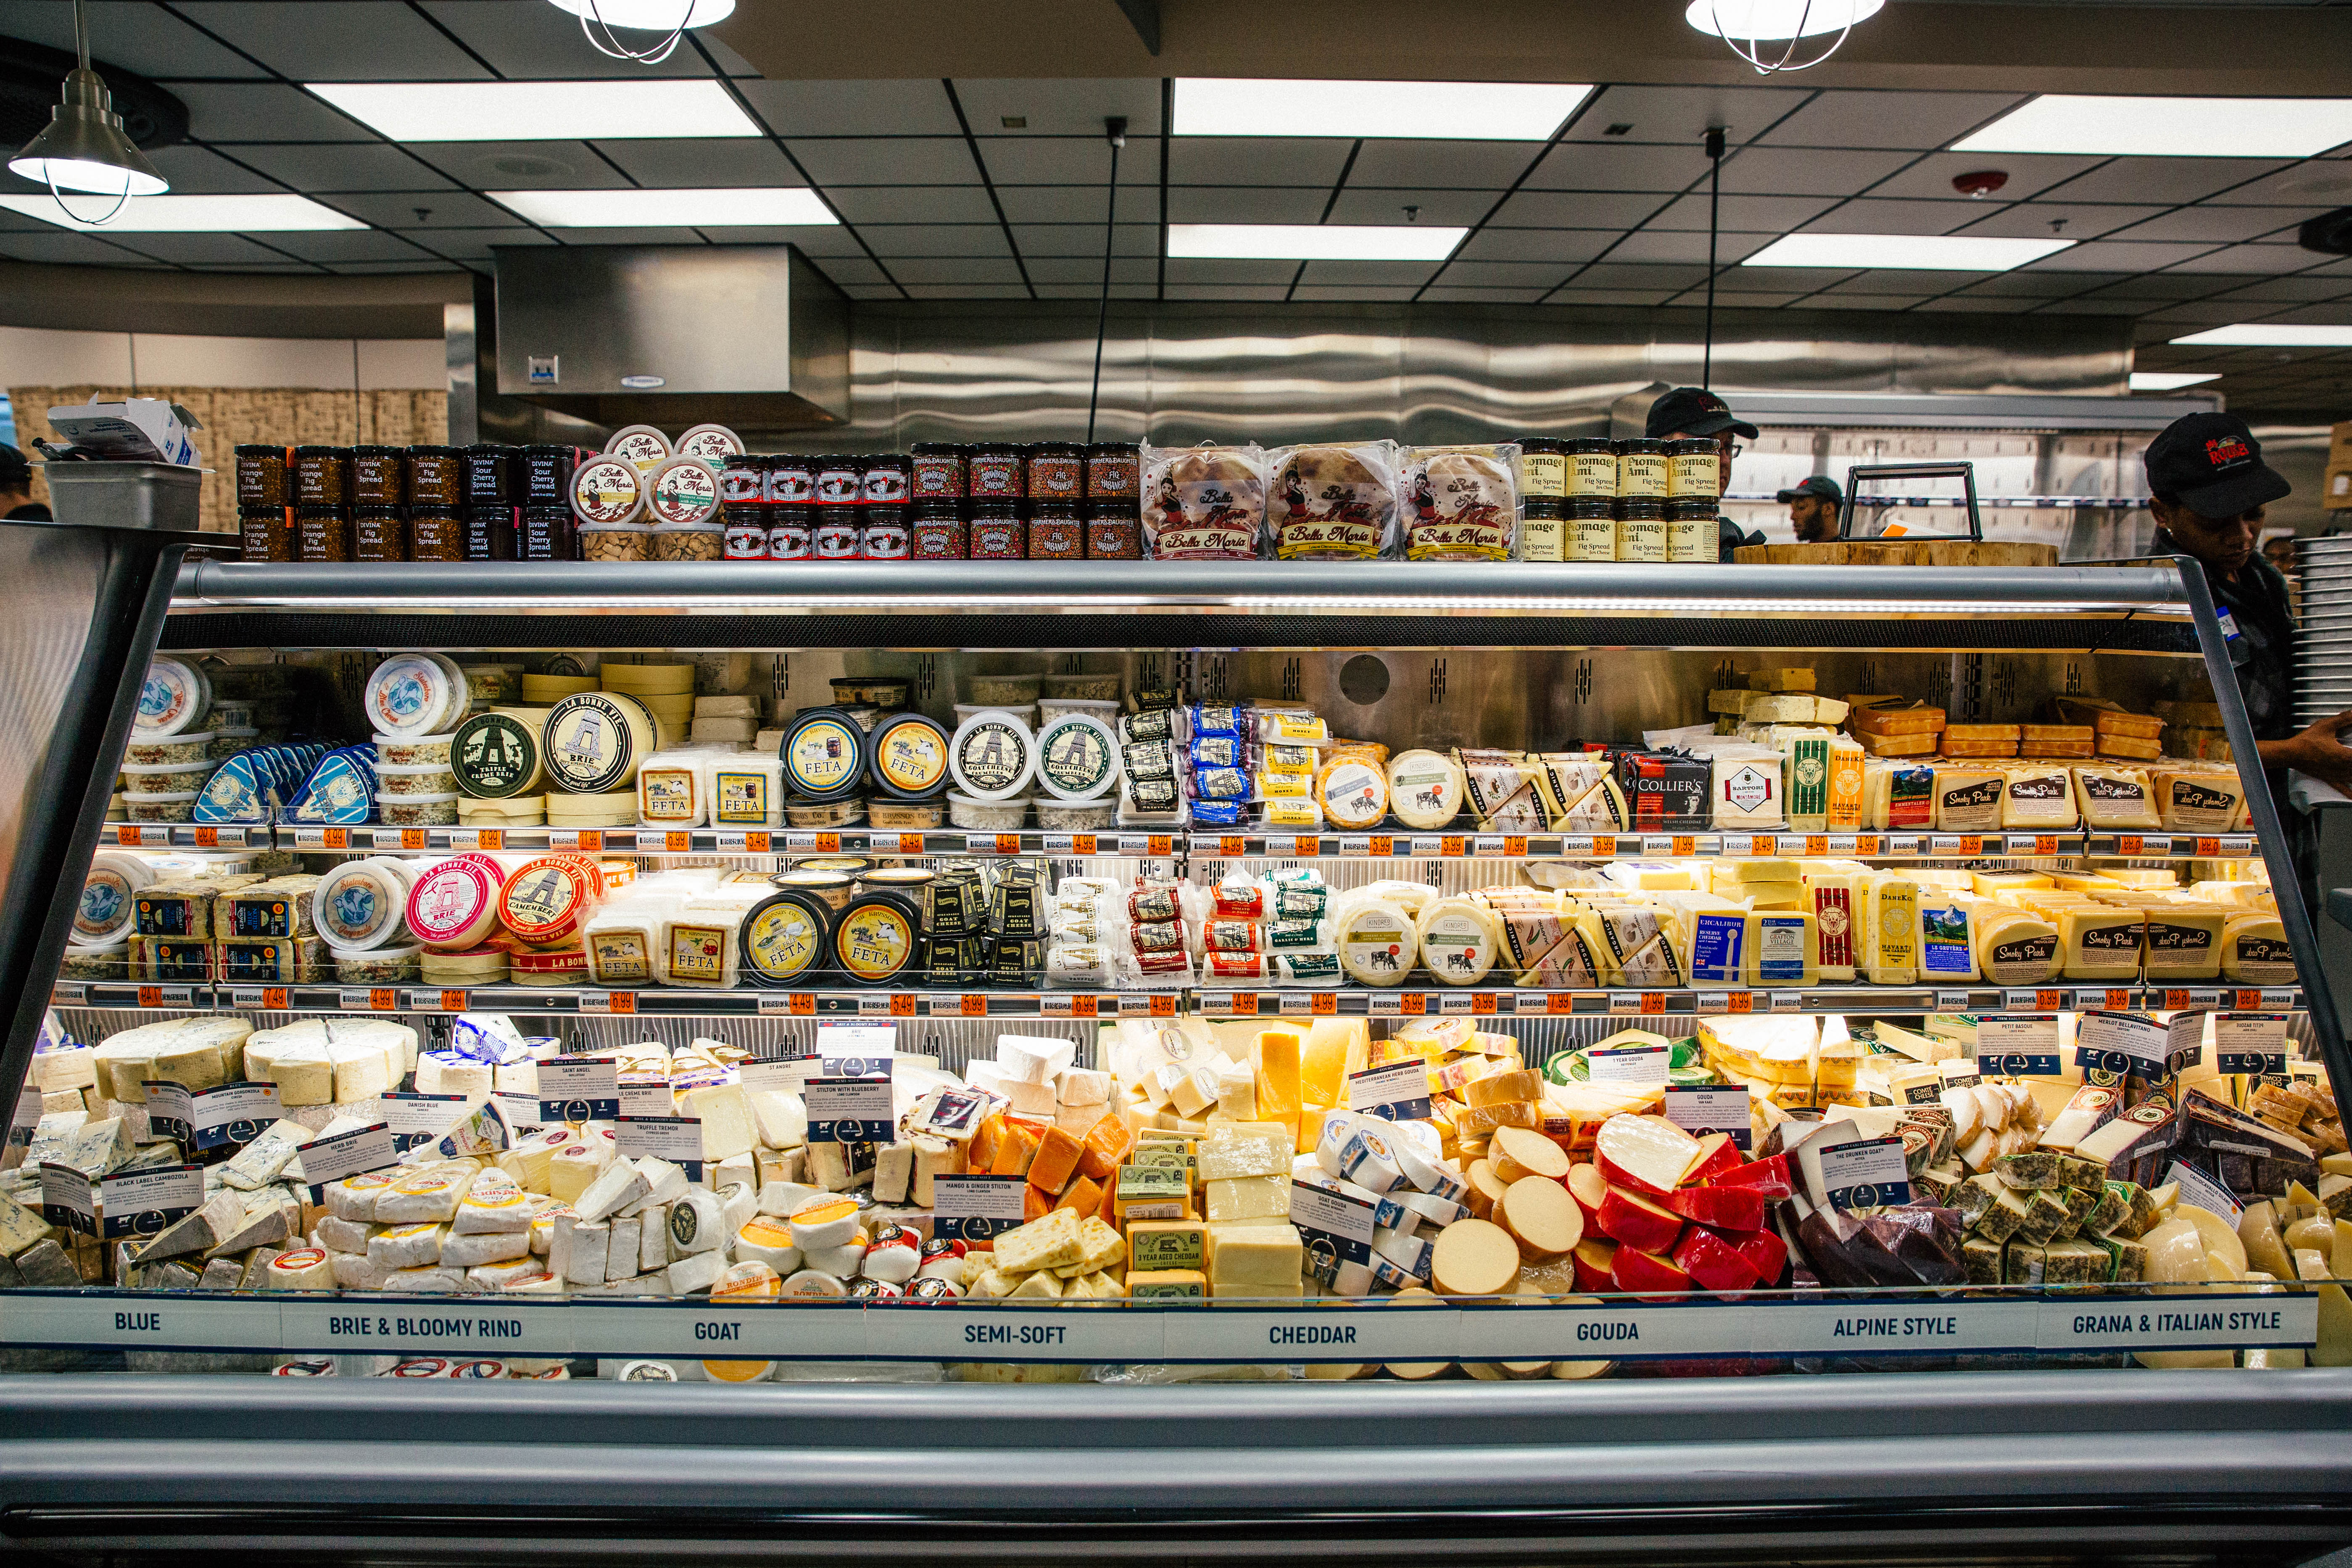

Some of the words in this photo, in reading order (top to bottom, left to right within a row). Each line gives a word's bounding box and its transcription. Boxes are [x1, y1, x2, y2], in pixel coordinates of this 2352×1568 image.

[913, 458, 931, 467] FARMER'S
[932, 458, 959, 467] DAUGHTER
[1672, 458, 1716, 468] Fromage
[599, 467, 624, 477] Bella
[680, 469, 704, 480] Bella
[920, 470, 947, 482] STRAWBERRY
[1109, 471, 1120, 480] FIG
[1101, 480, 1128, 490] HABANERO
[1165, 534, 1200, 548] Bella
[1205, 532, 1247, 551] María
[1418, 528, 1453, 543] Bella
[1456, 528, 1498, 547] María
[565, 698, 577, 709] LA
[580, 697, 608, 710] BONNE
[610, 708, 623, 728] VIE.
[570, 754, 595, 764] BRIE
[805, 761, 842, 774] FETA
[987, 765, 1012, 773] CHEESE
[1639, 779, 1702, 791] COLLIER'S
[1470, 780, 1485, 810] ORGANIC
[1950, 793, 1970, 806] Smoky
[1972, 792, 1991, 803] Park
[651, 801, 686, 812] FETA
[725, 800, 759, 811] FETA
[340, 878, 373, 891] Statesboro
[433, 910, 456, 920] BRIE
[509, 902, 556, 919] CAMEMBERT
[338, 925, 373, 937] Gorgonzola
[772, 945, 781, 953] FAT
[782, 937, 797, 947] FREE
[769, 942, 806, 967] FETA
[2098, 1019, 2117, 1027] MERLOT
[2119, 1022, 2151, 1033] BELLAVITANO
[1355, 1074, 1391, 1085] MEDITERRANEAN
[155, 1174, 188, 1183] CAMBOZOLA
[2190, 1174, 2218, 1194] CACIOCAVALLO
[2218, 1193, 2230, 1205] SILANO
[1331, 1199, 1347, 1209] GOUDA
[115, 1312, 161, 1331] BLUE
[330, 1318, 370, 1335] BRIE
[378, 1319, 390, 1336] &
[397, 1319, 473, 1337] BLOOMY
[479, 1319, 522, 1338] RIND
[1833, 1318, 1900, 1337] ALPINE
[1904, 1317, 1956, 1336] STYLE
[2073, 1313, 2133, 1334] GRANA
[2138, 1313, 2150, 1333] &
[2157, 1312, 2223, 1333] ITALIAN
[2228, 1311, 2281, 1330] STYLE
[695, 1322, 741, 1341] GOAT
[964, 1325, 1066, 1344] SEMI-SOFT
[1269, 1326, 1356, 1345] CHEDDAR
[1577, 1323, 1639, 1341] GOUDA
